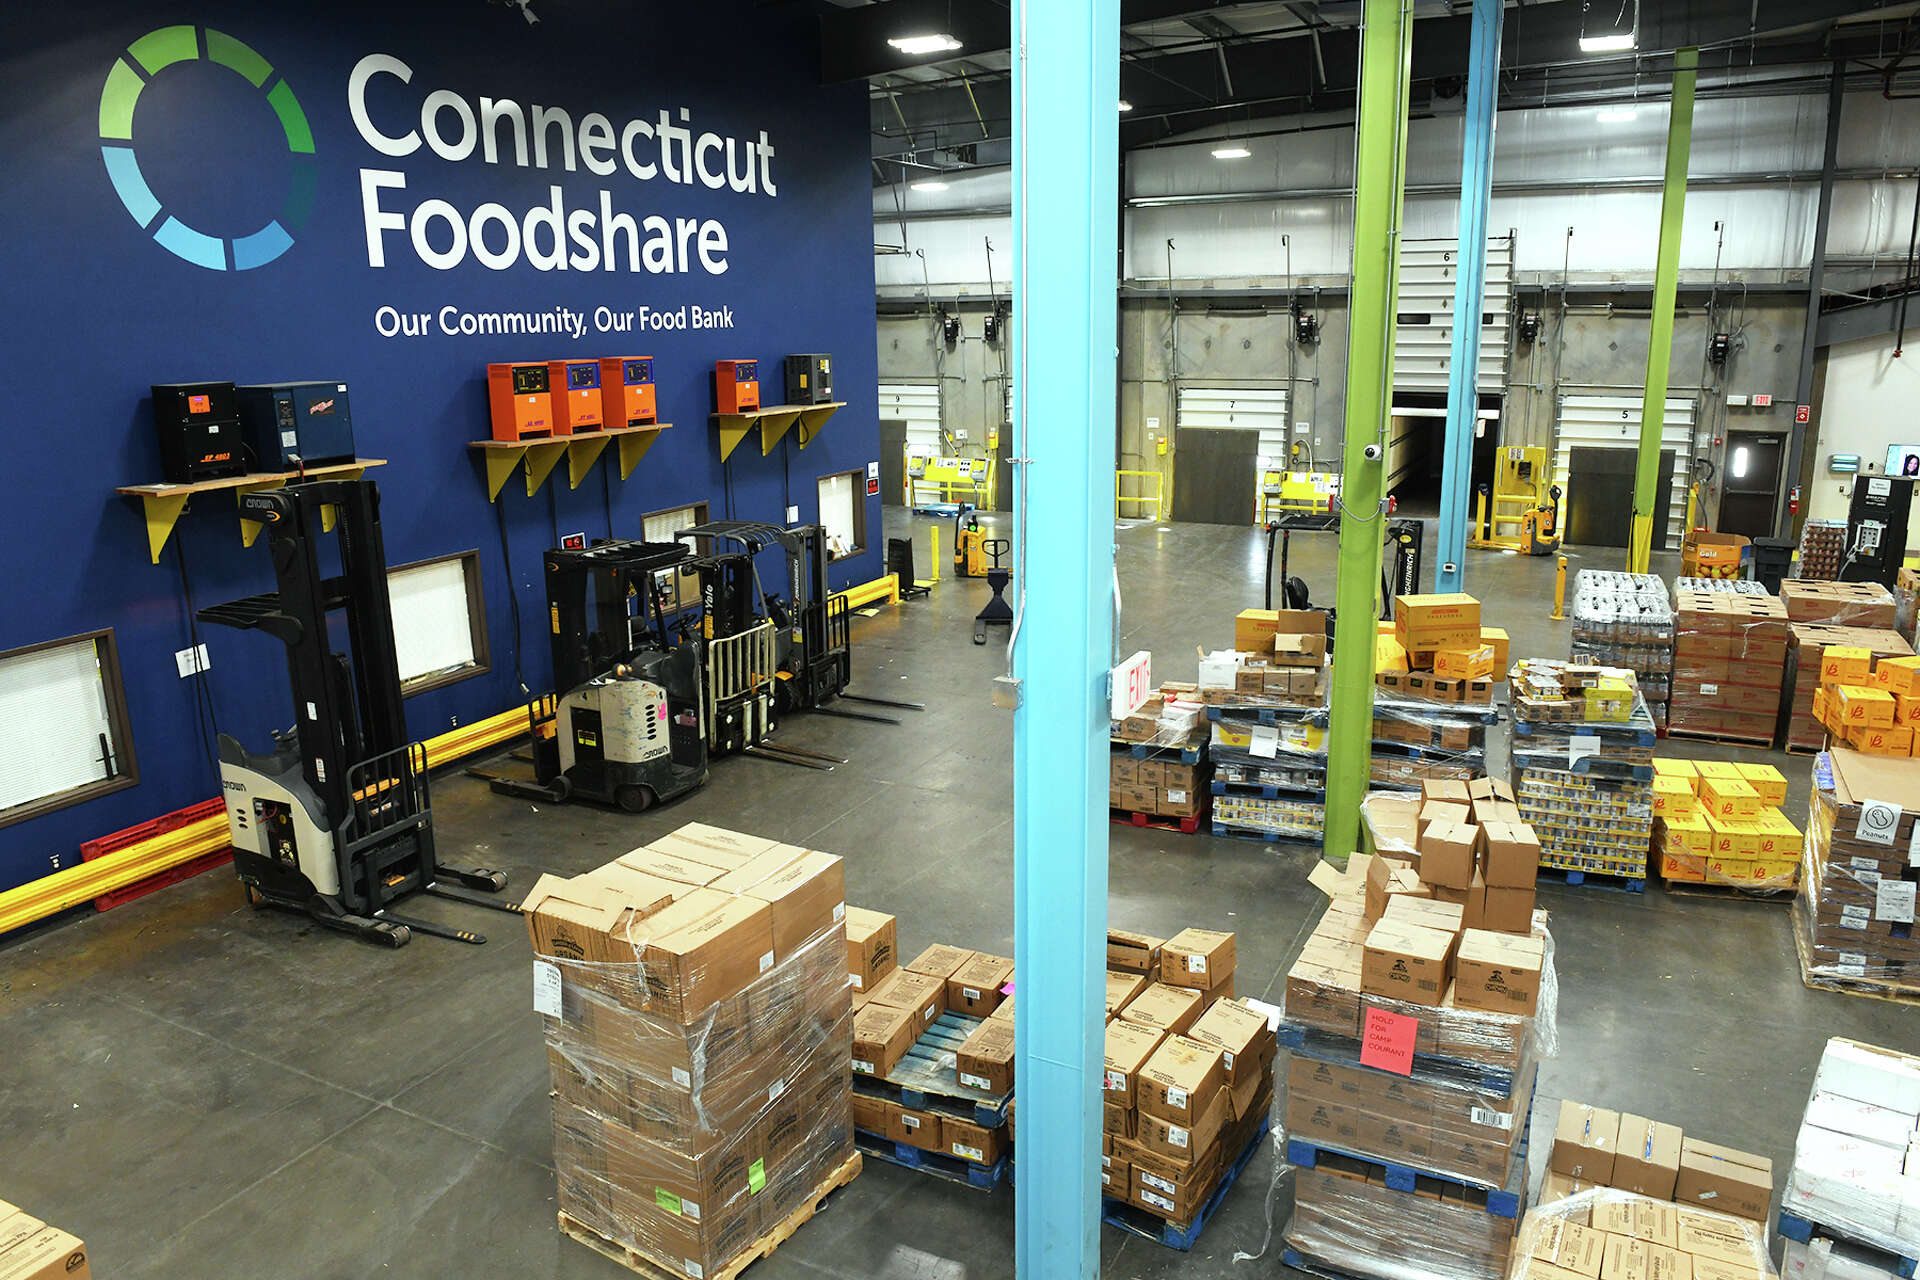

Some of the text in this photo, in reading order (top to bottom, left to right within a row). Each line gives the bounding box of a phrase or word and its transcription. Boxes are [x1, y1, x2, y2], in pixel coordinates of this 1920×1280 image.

[348, 53, 777, 197] Connecticut
[359, 168, 730, 275] Foodshare
[1443, 252, 1451, 262] 6
[375, 305, 735, 339] Our Community, Our Food Bank
[895, 394, 900, 403] 9
[1229, 400, 1235, 409] 7
[1621, 410, 1629, 419] 5
[704, 584, 714, 609] Yale
[1128, 659, 1150, 710] EXIT
[1861, 830, 1889, 840] Peanuts
[1372, 1014, 1394, 1025] HOLD
[1371, 1023, 1387, 1033] FOR
